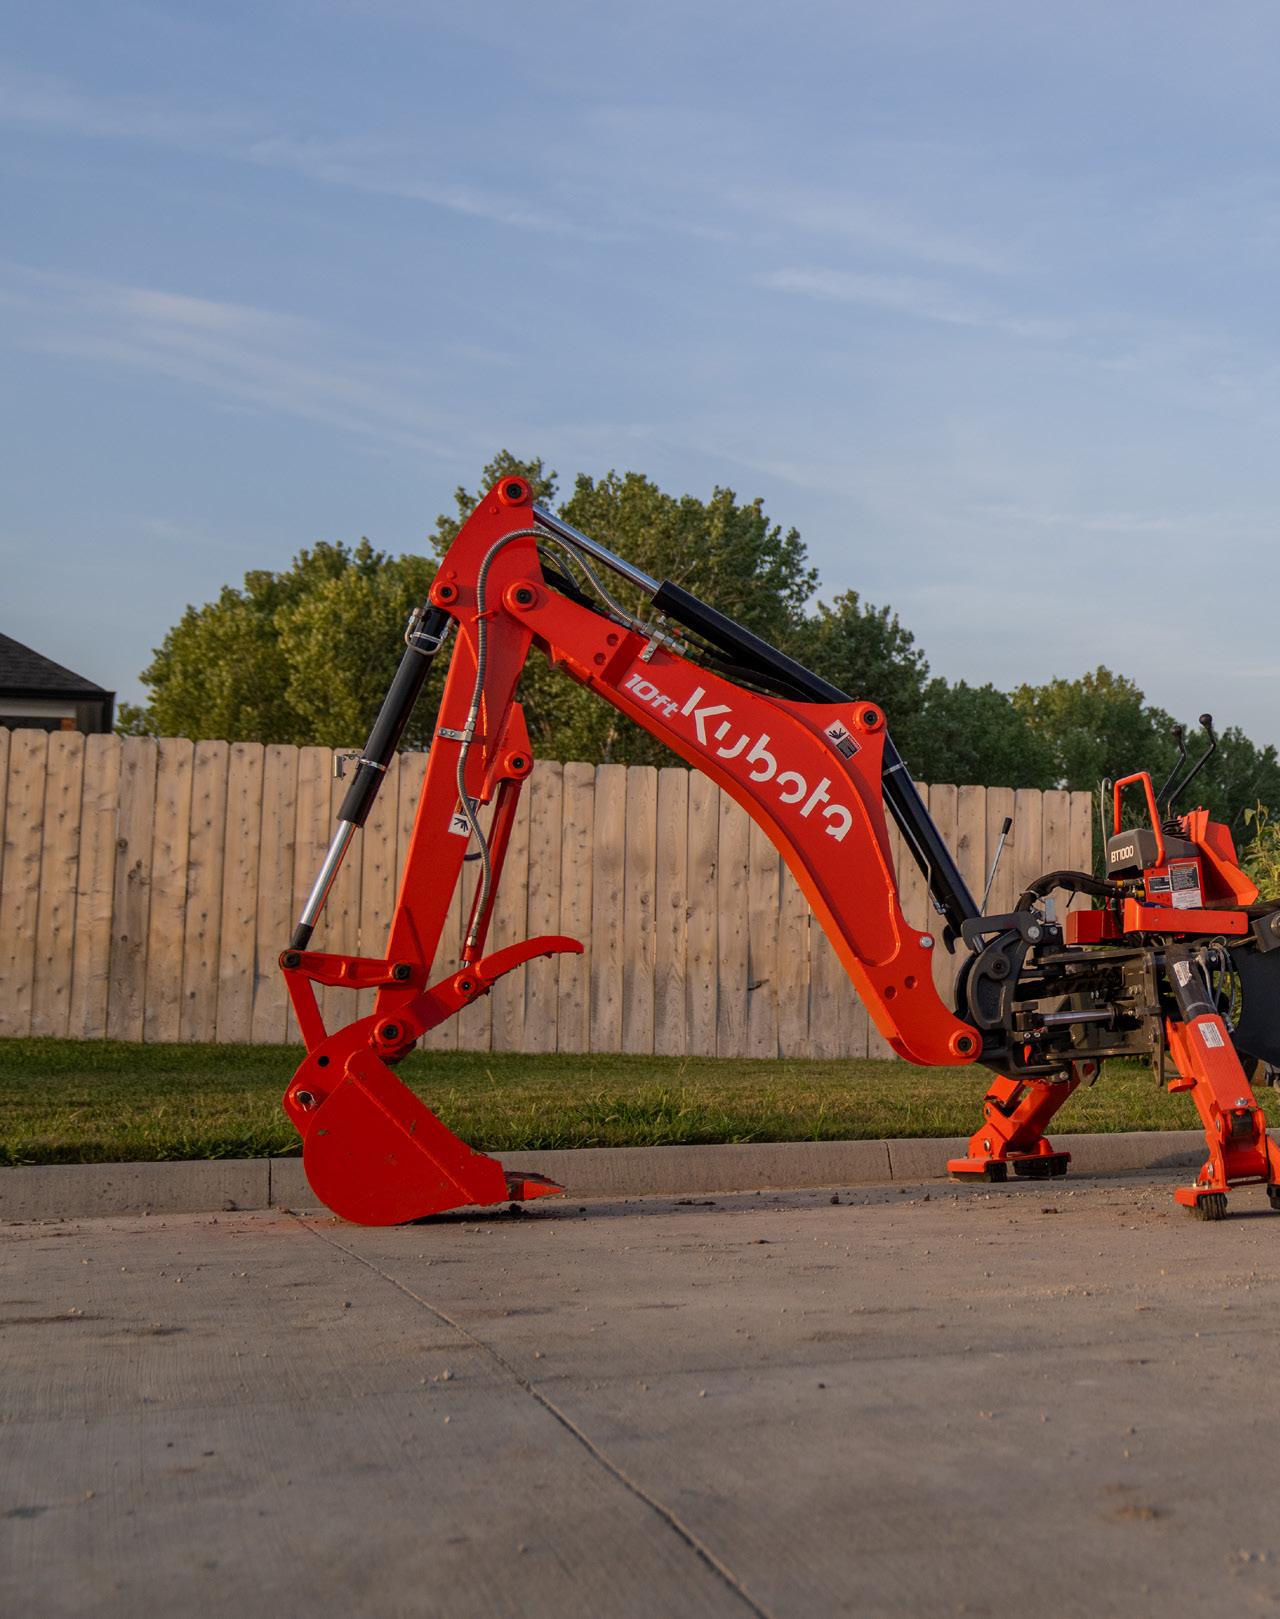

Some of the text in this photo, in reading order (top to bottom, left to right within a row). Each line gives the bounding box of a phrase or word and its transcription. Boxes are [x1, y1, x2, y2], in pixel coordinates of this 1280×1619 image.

[624, 673, 853, 843] 10ft Kubota
[1110, 845, 1134, 863] BT1000
